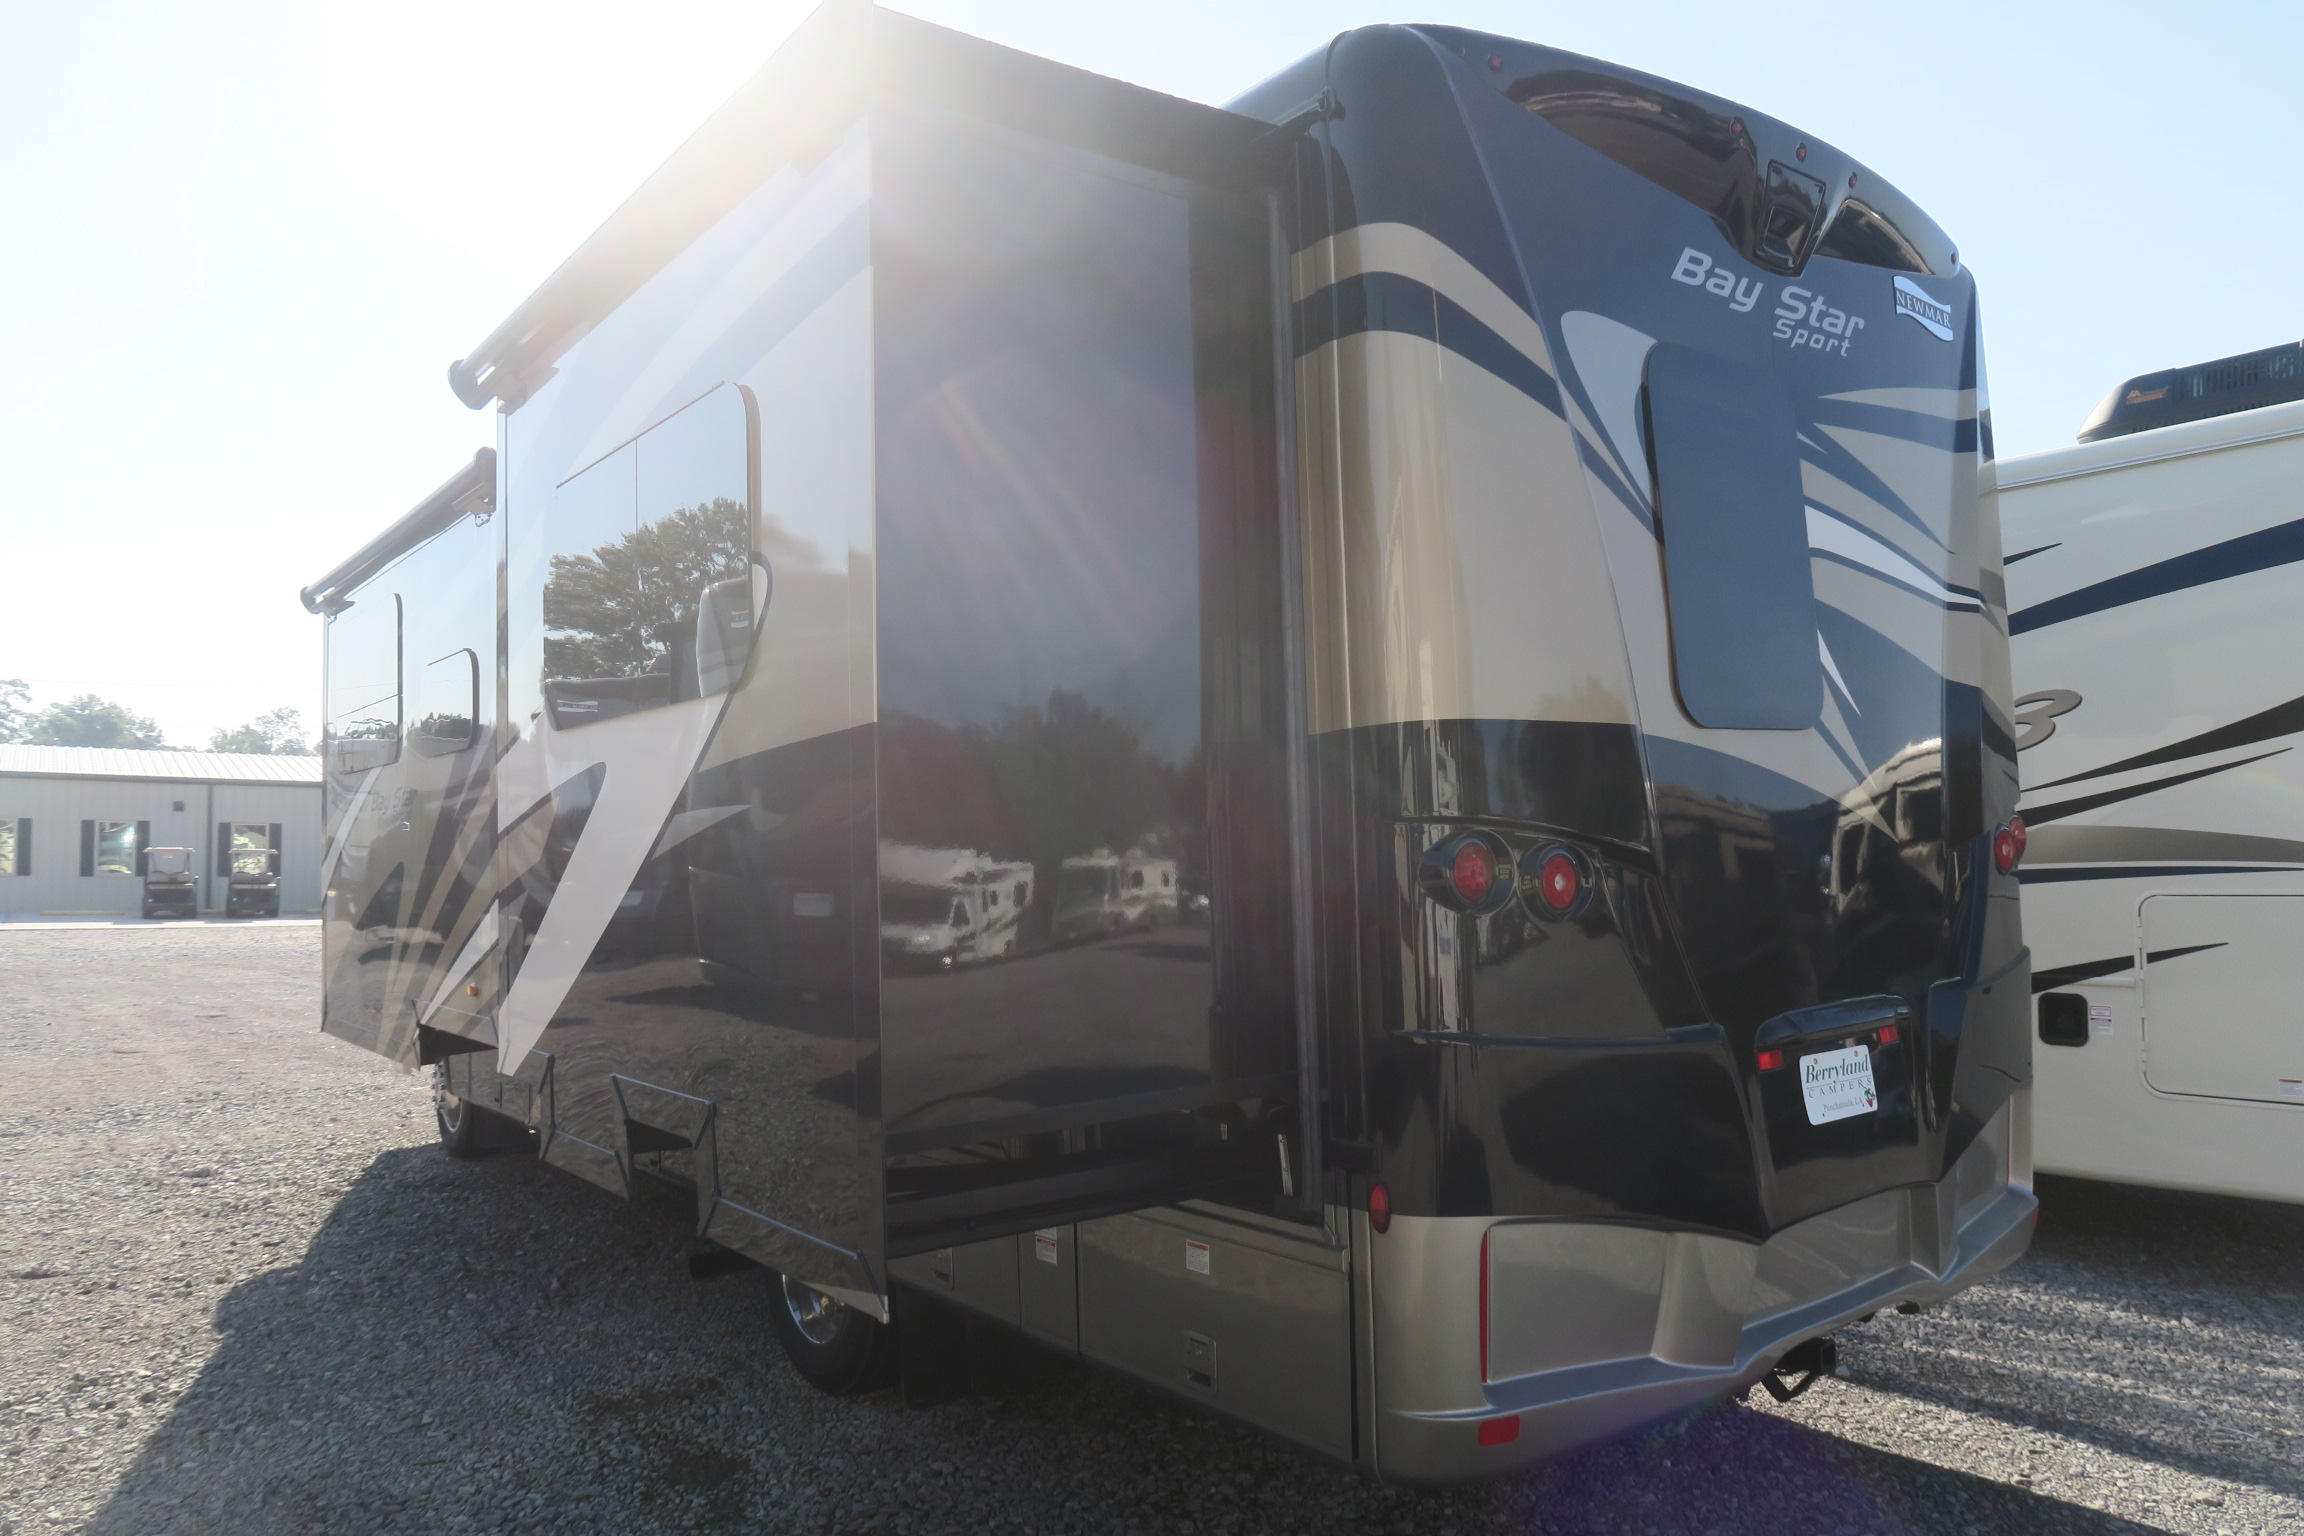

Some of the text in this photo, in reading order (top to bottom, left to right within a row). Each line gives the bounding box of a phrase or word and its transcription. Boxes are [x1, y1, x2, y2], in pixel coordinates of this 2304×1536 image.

[1671, 247, 1865, 338] Bay Star
[1896, 289, 1951, 328] NEWMAR
[1772, 319, 1851, 357] Sport
[1806, 1054, 1868, 1083] Berryland
[1808, 1077, 1871, 1098] CAMPERS
